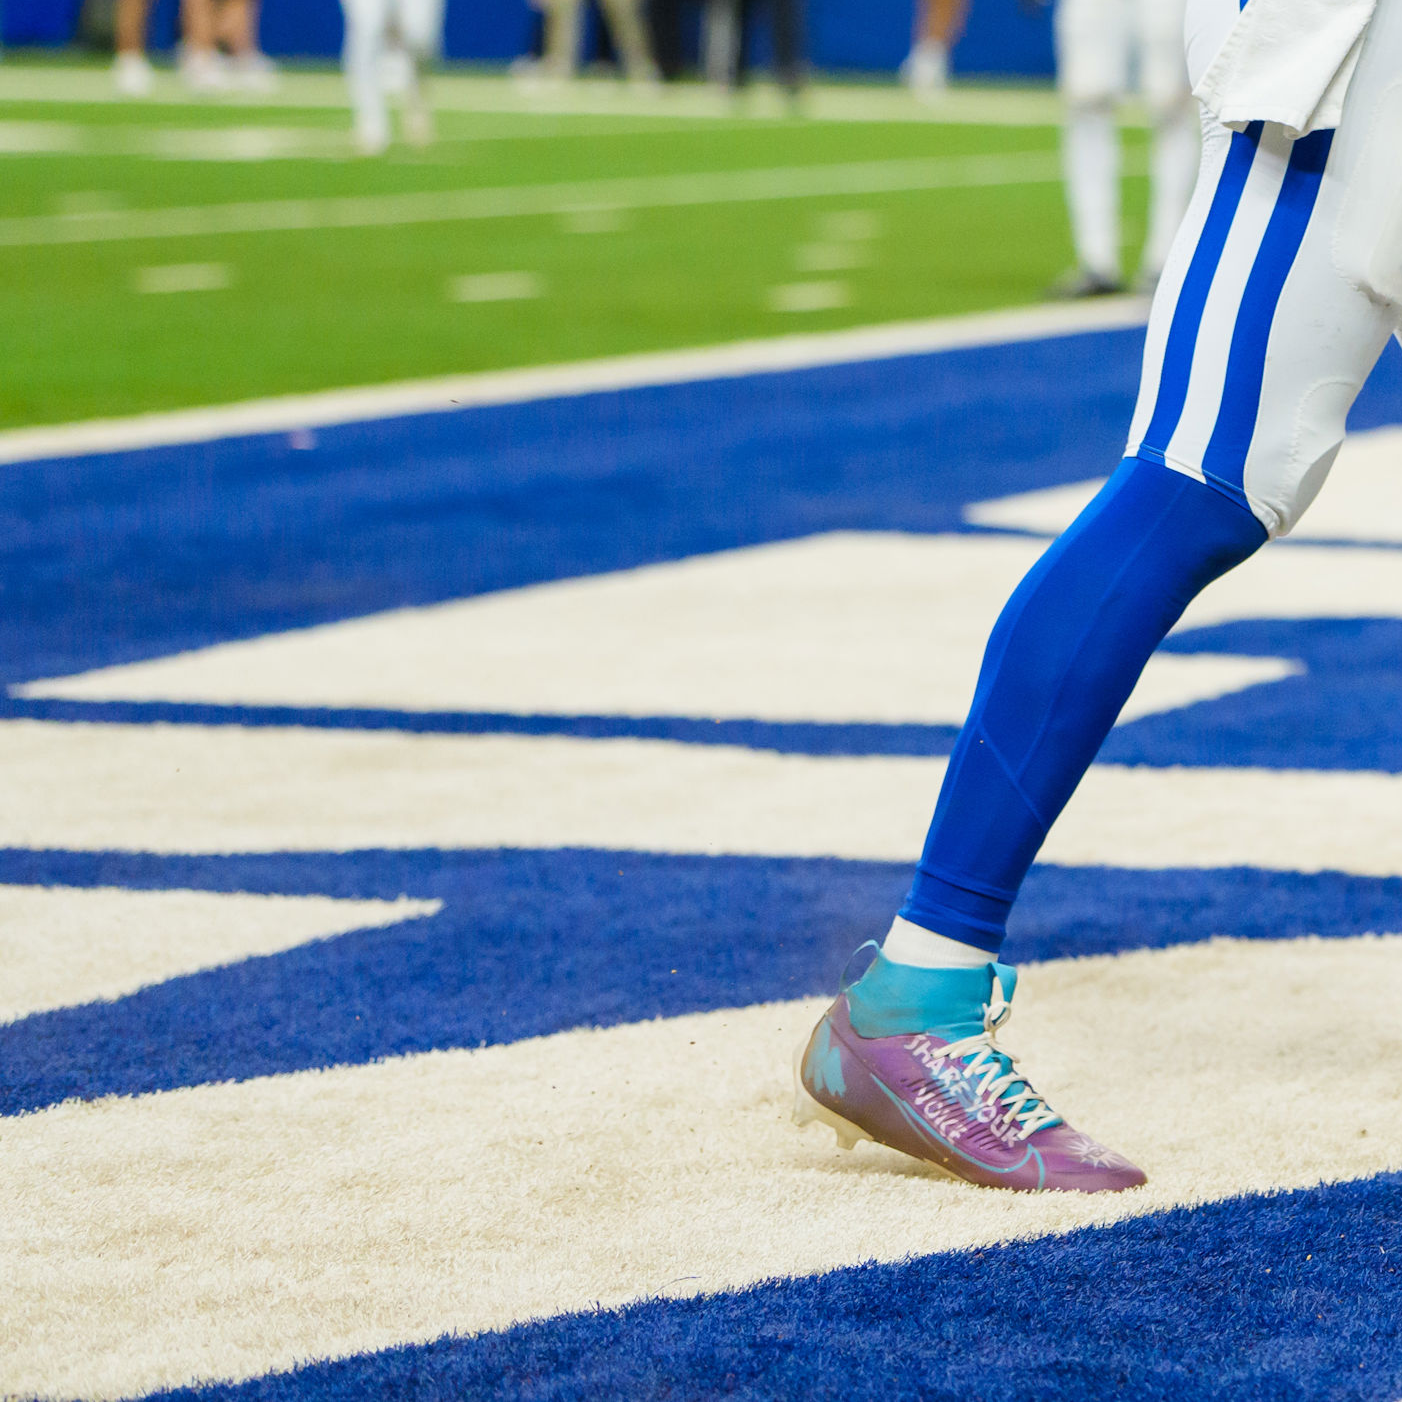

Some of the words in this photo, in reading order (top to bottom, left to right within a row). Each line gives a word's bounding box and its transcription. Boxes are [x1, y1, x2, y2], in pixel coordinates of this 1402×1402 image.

[903, 1034, 972, 1097] SHARE
[965, 1097, 1022, 1149] YOUR
[914, 1086, 968, 1145] VOICE
